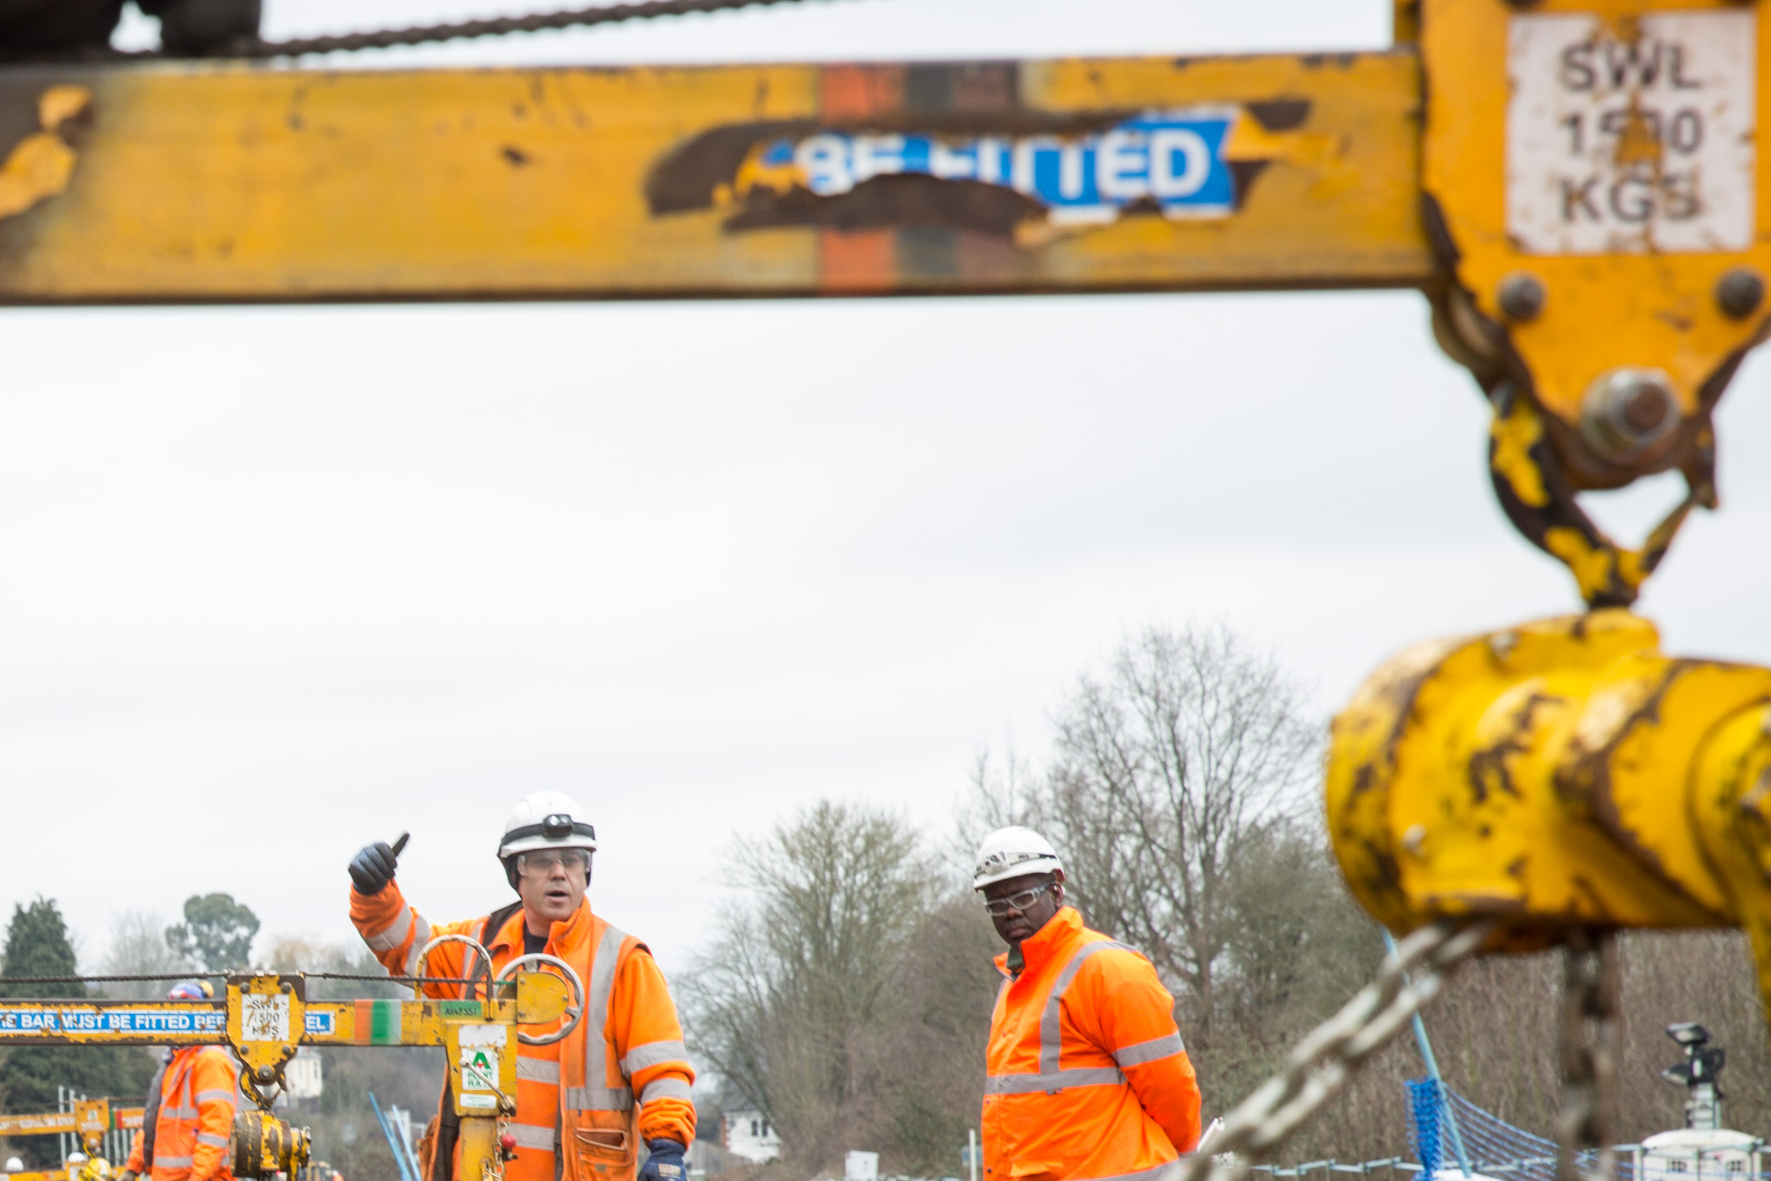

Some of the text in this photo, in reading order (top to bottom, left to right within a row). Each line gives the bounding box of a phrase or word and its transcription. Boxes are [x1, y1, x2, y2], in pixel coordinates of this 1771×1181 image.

[1559, 40, 1702, 92] SWL
[1559, 170, 1703, 223] KGS
[21, 1014, 56, 1029] BAR
[109, 1014, 132, 1029] BE
[135, 1014, 190, 1029] FITTED
[193, 1015, 226, 1030] BEF
[305, 1015, 326, 1030] EL
